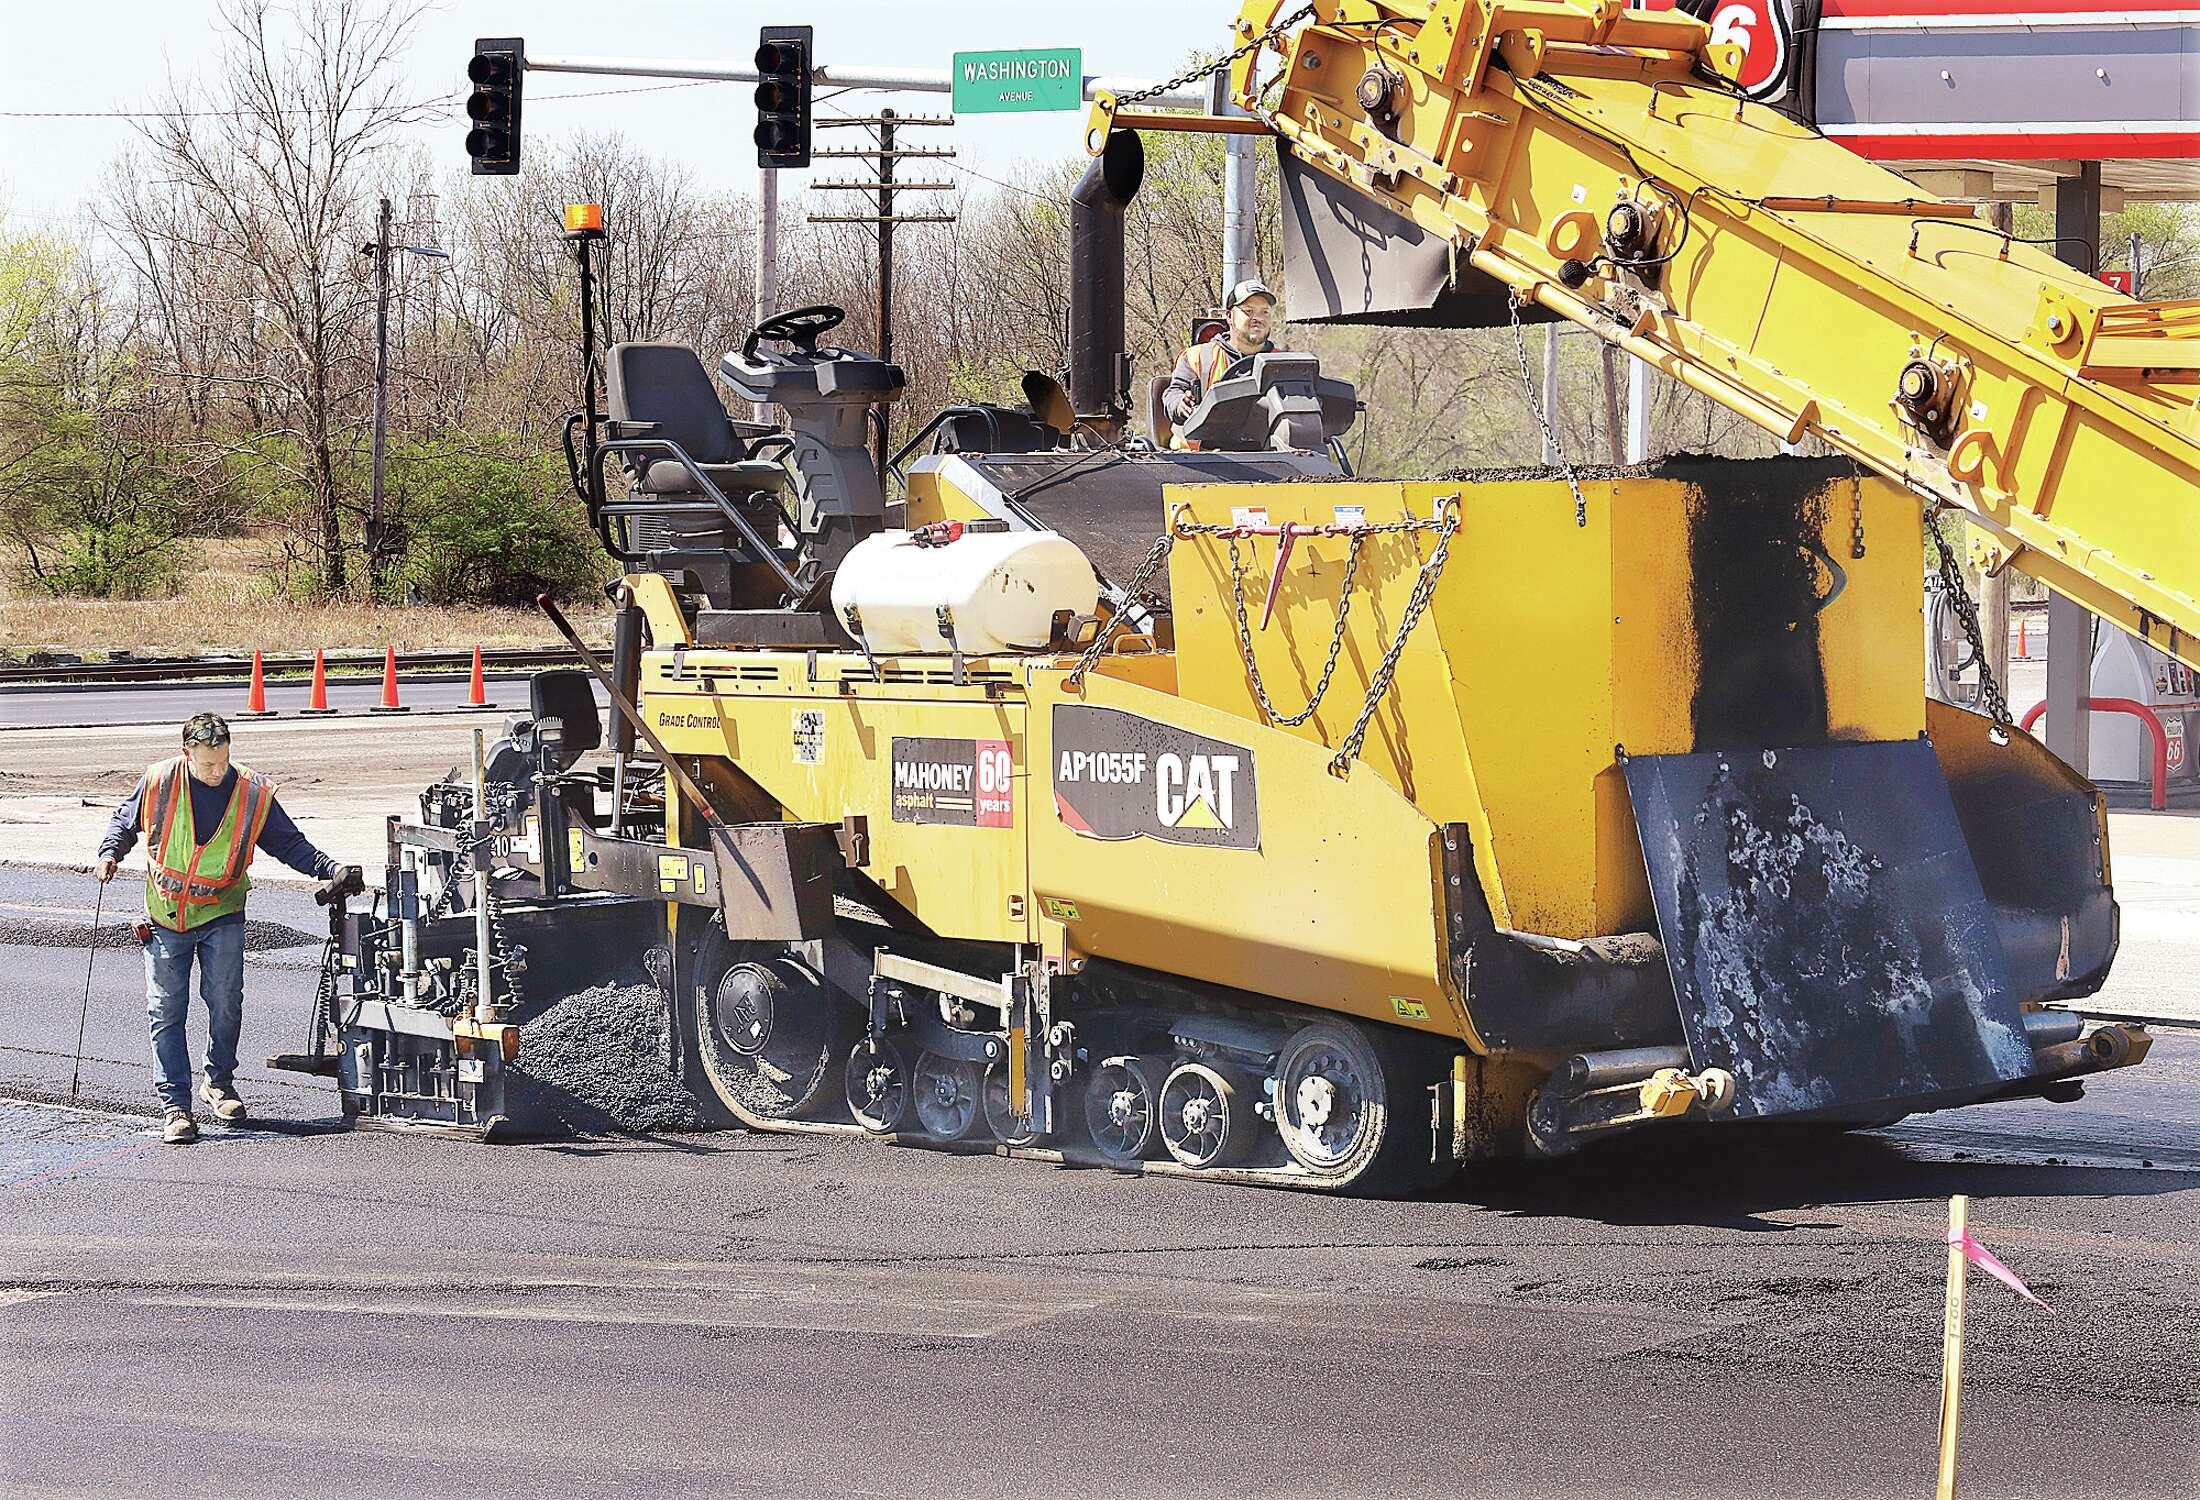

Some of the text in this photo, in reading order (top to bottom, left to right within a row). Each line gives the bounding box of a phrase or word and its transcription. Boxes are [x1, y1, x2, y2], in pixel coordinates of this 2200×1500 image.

[964, 59, 1071, 81] WASHINGTON
[999, 90, 1033, 102] AVENUE
[2109, 276, 2122, 289] 7
[659, 712, 721, 729] GRADE CONTROL
[2166, 740, 2181, 761] 66
[895, 761, 974, 792] MAHONEY
[978, 749, 1011, 794] 60
[1058, 750, 1240, 830] AP1055F CAT
[895, 791, 934, 811] asphalt
[979, 798, 1011, 815] years
